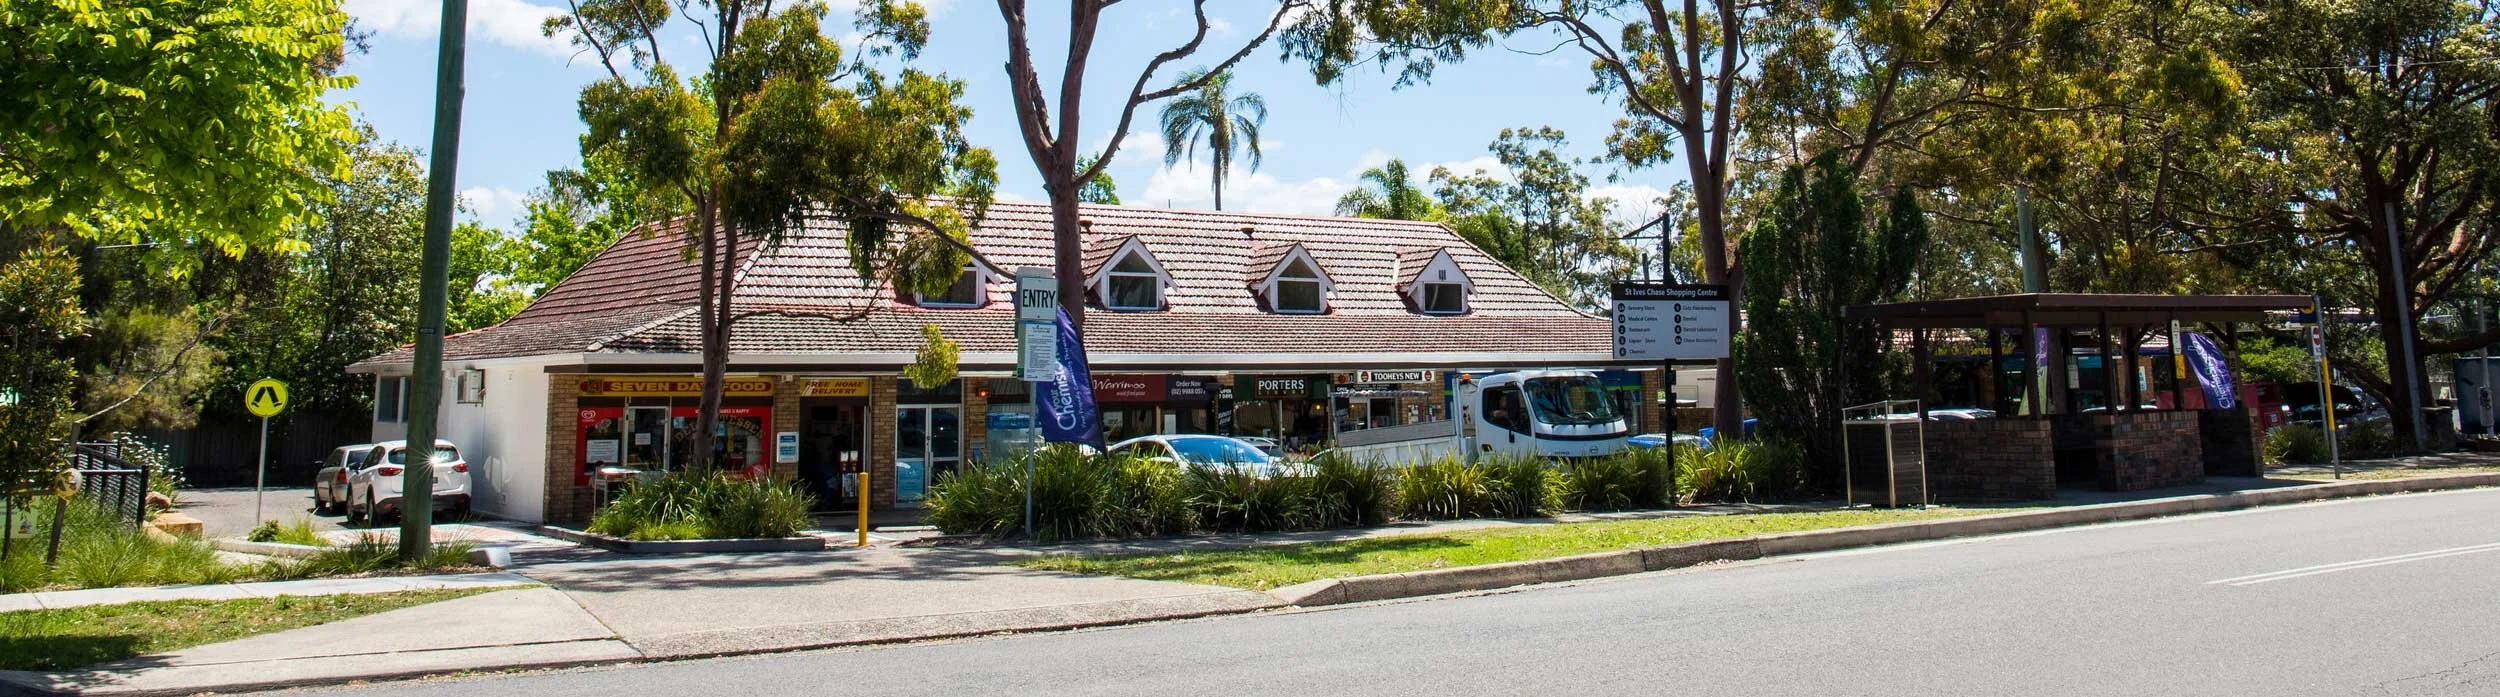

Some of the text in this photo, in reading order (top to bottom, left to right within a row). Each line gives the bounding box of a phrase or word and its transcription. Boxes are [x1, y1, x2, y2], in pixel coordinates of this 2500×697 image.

[1625, 288, 1718, 298] St Ives Chase Shopping Centre
[1022, 288, 1056, 309] ENTRY
[1374, 372, 1419, 380] TOOHEYS NEW
[610, 382, 766, 391] SEVEN DA FOOD
[1093, 379, 1146, 390] Warrimoo
[1258, 379, 1305, 390] PORTERS
